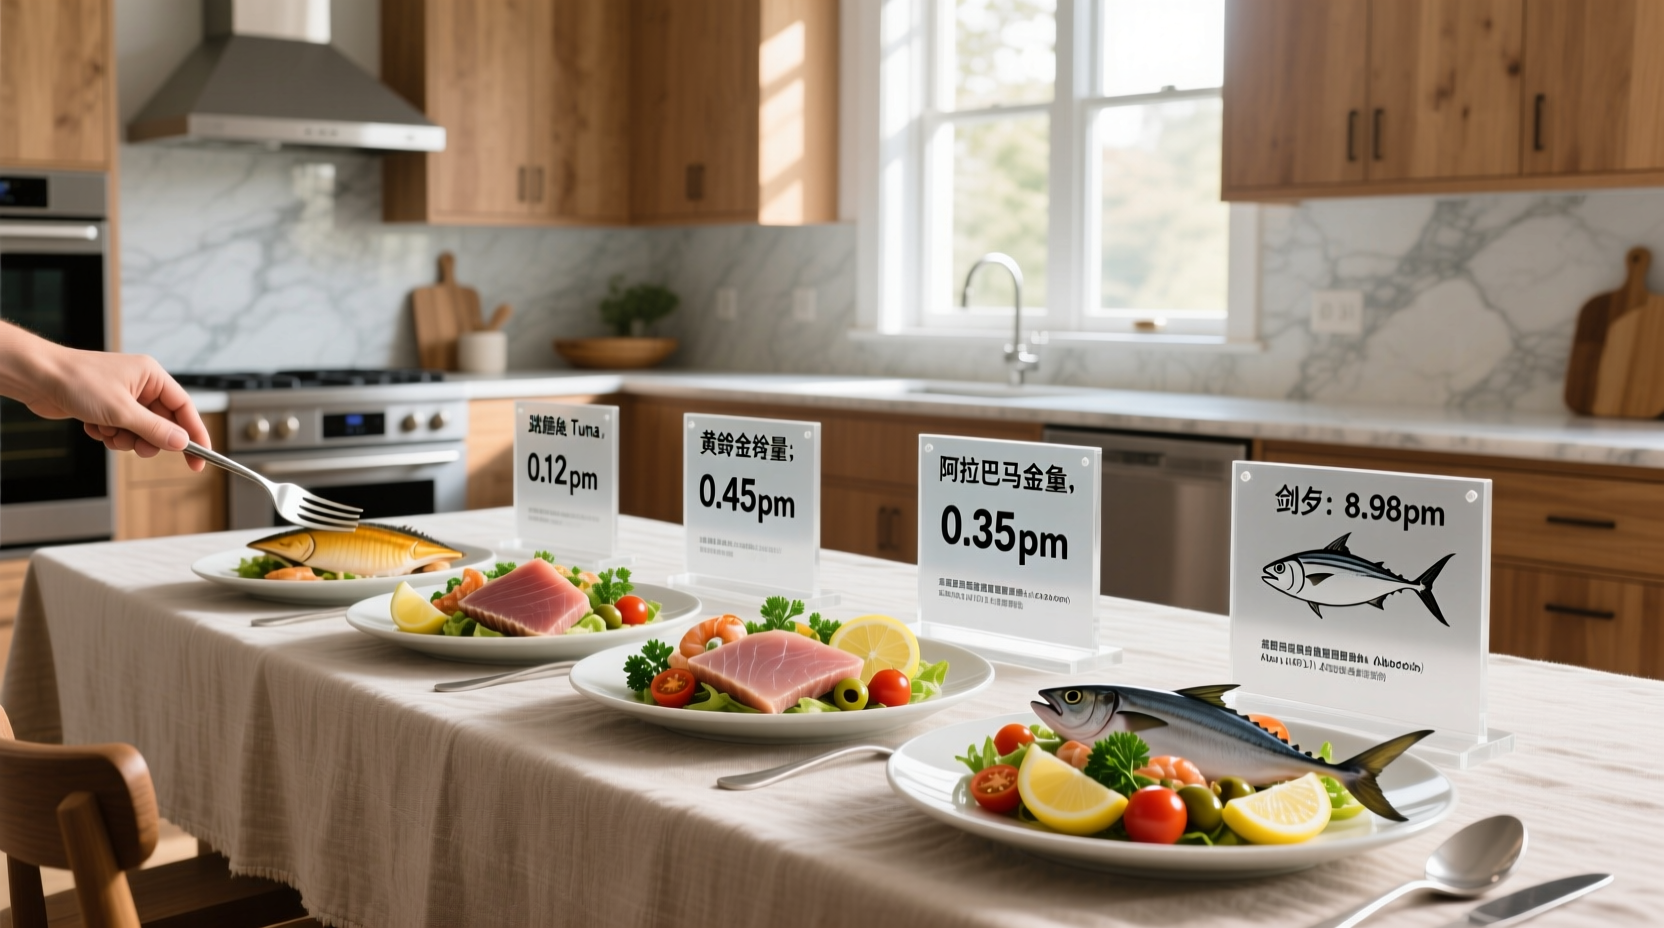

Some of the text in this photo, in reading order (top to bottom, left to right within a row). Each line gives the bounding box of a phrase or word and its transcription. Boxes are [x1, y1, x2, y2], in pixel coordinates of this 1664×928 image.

[527, 452, 598, 496] 0.12pm
[699, 473, 795, 524] 0.45pm
[1344, 492, 1445, 531] 8.98pm
[941, 504, 1068, 566] 0.35pm
